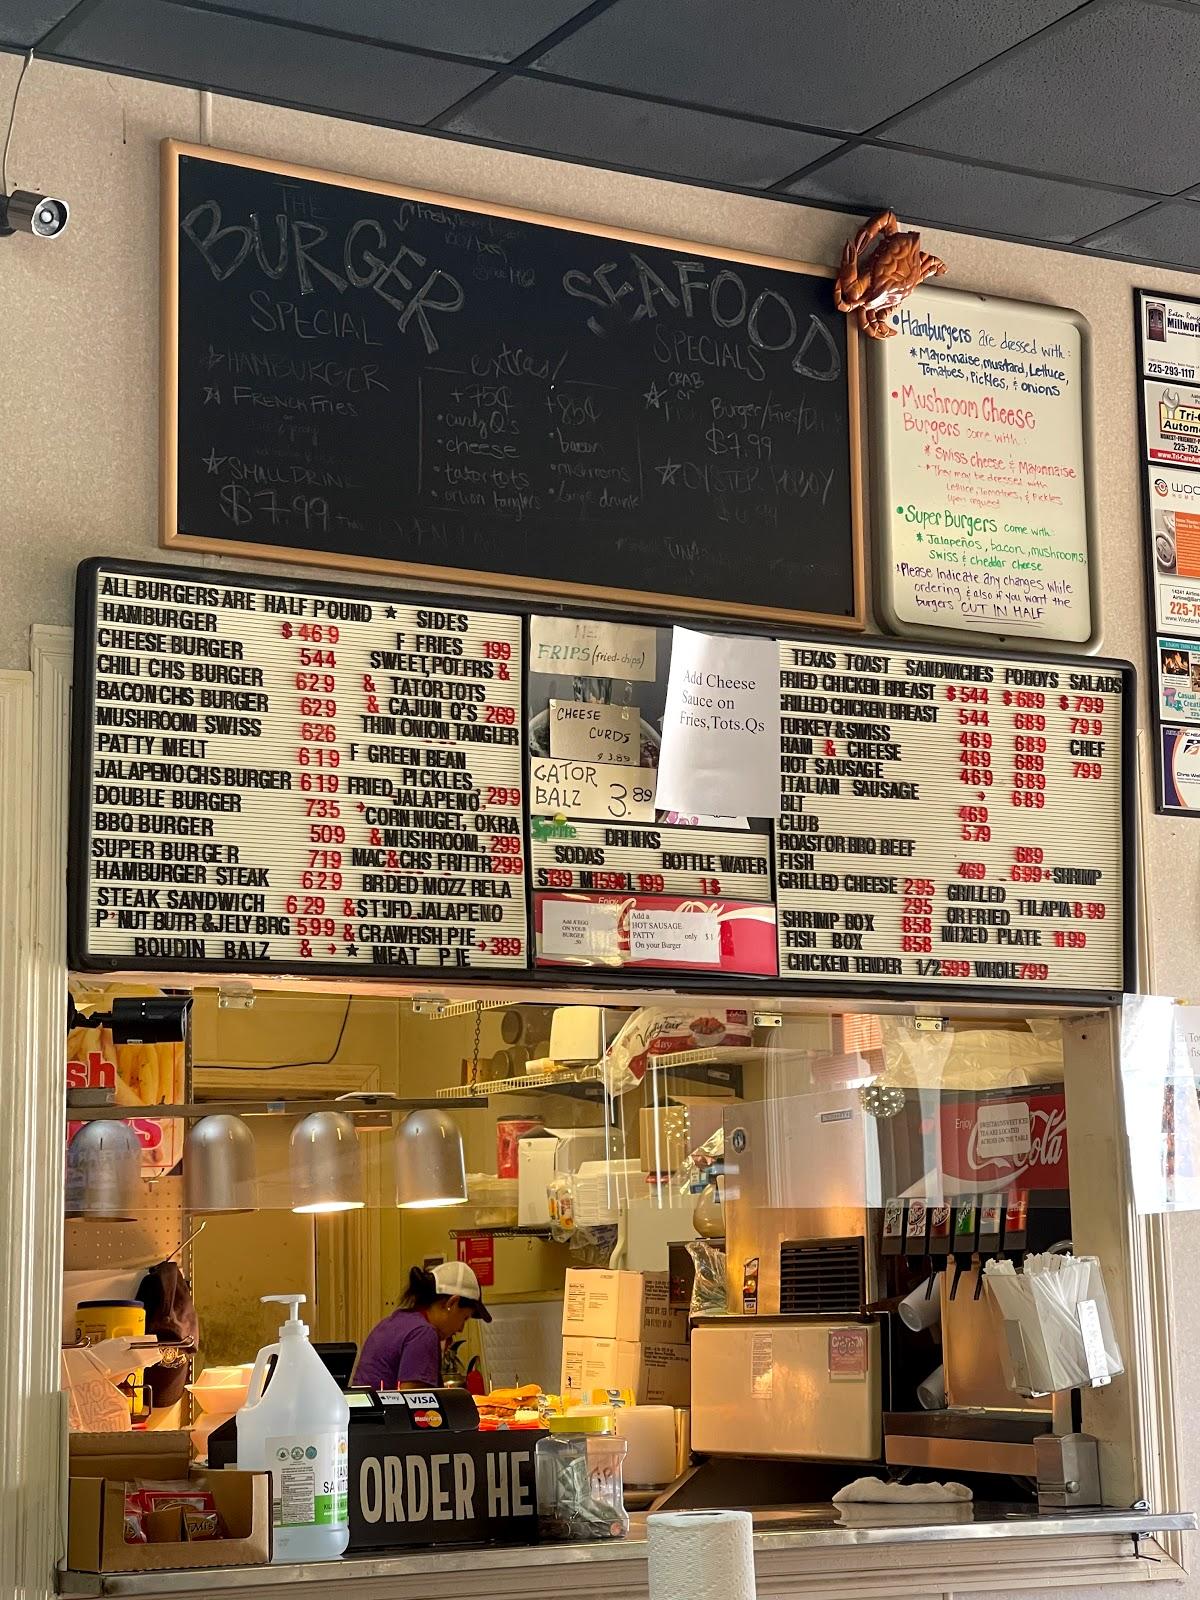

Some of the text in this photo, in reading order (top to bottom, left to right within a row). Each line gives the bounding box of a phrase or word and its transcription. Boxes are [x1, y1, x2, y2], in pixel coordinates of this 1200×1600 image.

[181, 200, 464, 354] BURGER
[251, 290, 383, 346] SPECIAL
[563, 254, 840, 381] SEAFOOD
[901, 310, 1037, 354] Hamburgers are dressed
[654, 324, 766, 380] SPECIALS
[1148, 363, 1195, 379] 225-293-1117
[1021, 383, 1060, 396] onions
[902, 385, 1036, 429] Mushroom Cheese
[706, 422, 772, 459] $7.99
[904, 412, 960, 444] Burgers
[447, 437, 520, 458] cheese
[970, 452, 1077, 479] cheese Mayonnaise
[220, 482, 329, 530] $7.99
[905, 505, 1028, 536] Super Burgers come
[970, 557, 1043, 571] cheddar cheese
[901, 563, 1044, 594] Please Indicate any changes
[102, 577, 372, 622] ALL BURGERS ARE POUND
[915, 583, 1072, 608] ordering also you want the
[916, 596, 1045, 619] burgers CUT IN HALF
[103, 603, 217, 632] HAMBURGER
[417, 610, 468, 632] SIDES
[98, 628, 336, 668] CHEESE BURGER 544
[416, 634, 463, 655] FRIES
[538, 643, 591, 662] FRIPS
[98, 654, 263, 687] CHILI CHS BURGER
[684, 670, 756, 690] Add Cheese
[792, 649, 1122, 693] TEXAS TOAST SANDWICHES SALADS
[97, 681, 268, 712] BACON BURGER
[681, 690, 735, 709] Sauce on
[823, 675, 936, 700] CHICKEN BREAST
[388, 697, 442, 718] CAJUN
[557, 708, 600, 720] CHEESE
[831, 698, 887, 717] CHICKEN
[97, 706, 262, 736] MUSHROOM SWISS
[361, 715, 519, 746] THIN ONION TANGLER
[589, 728, 631, 743] CURDS
[98, 733, 340, 768] PATTY MELT 619
[368, 745, 466, 769] GREEN BEAN
[848, 741, 901, 761] CHEESE
[95, 759, 339, 793] JALAPENO CHS BURGER 619
[534, 762, 598, 787] GATOR
[815, 758, 884, 778] SAUSAGE
[95, 785, 340, 818] DOUBLE BURGER 735
[535, 786, 581, 808] BALZ
[853, 779, 919, 800] SAUSAGE
[95, 812, 345, 844] BBQ BURGER 509
[365, 807, 520, 834] CORN OKRA
[532, 815, 577, 842] Sprite
[779, 814, 819, 832] CLUB
[605, 829, 661, 849] DRINKS
[848, 837, 916, 856] BBQ BEEF
[92, 838, 342, 869] SUPER BURGER 719
[555, 846, 767, 875] SODAS BOTTLE WATER
[95, 861, 269, 887] HAMBURGER STEAK
[780, 853, 1102, 885] FISH SHRIMP
[778, 872, 898, 894] GRILLED CHEESE
[97, 887, 265, 913] STEAK SANDWICH
[297, 918, 336, 936] 599
[783, 911, 875, 931] SHRIMP BOX
[134, 937, 270, 960] BOUDIN BALZ
[448, 927, 475, 946] PIE
[786, 930, 863, 950] FISH BOX
[942, 926, 1042, 946] MIXED PLATE
[373, 945, 420, 965] MEAT
[788, 953, 902, 975] CHICKEN TENDER
[359, 1452, 476, 1524] ORDER
